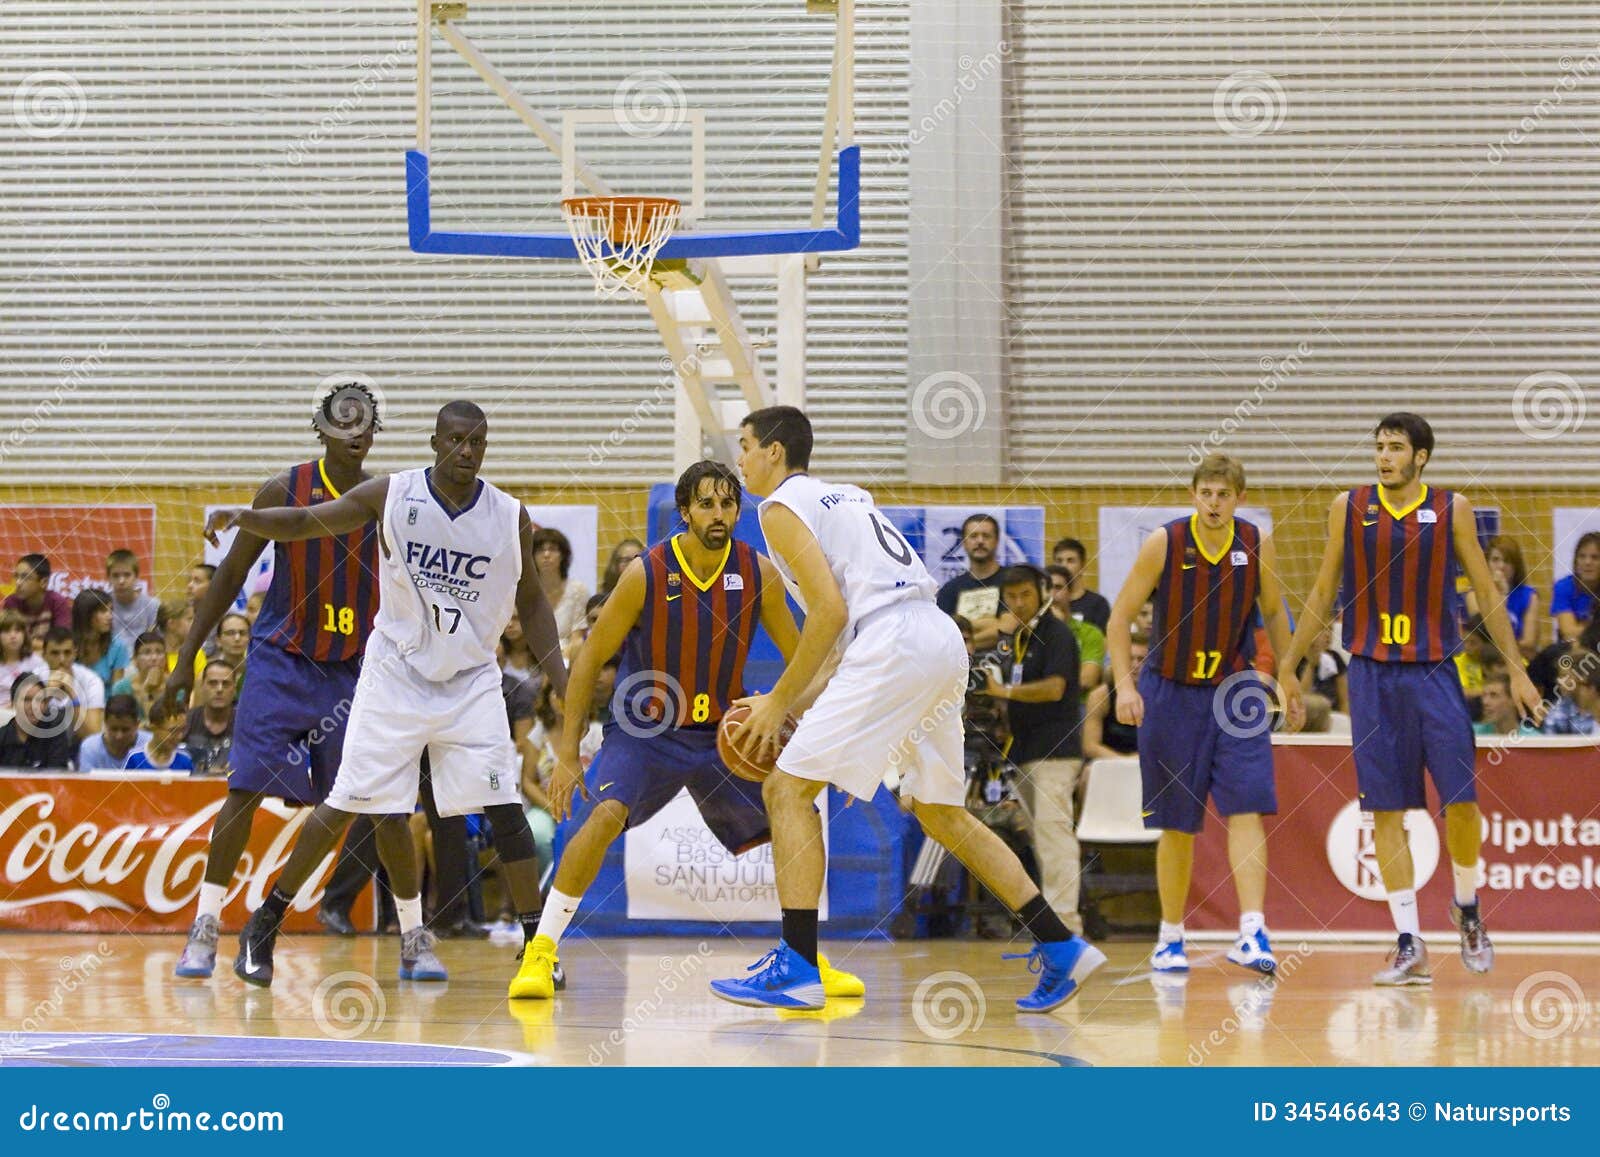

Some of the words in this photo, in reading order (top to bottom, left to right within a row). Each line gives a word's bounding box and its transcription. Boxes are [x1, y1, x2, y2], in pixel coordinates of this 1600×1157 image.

[868, 513, 912, 566] 6
[406, 541, 492, 580] FIATC
[323, 603, 355, 636] 18
[432, 603, 462, 635] 17
[1380, 612, 1411, 645] 10
[1192, 651, 1223, 680] 17
[692, 693, 710, 723] 8
[1475, 856, 1600, 890] arcel
